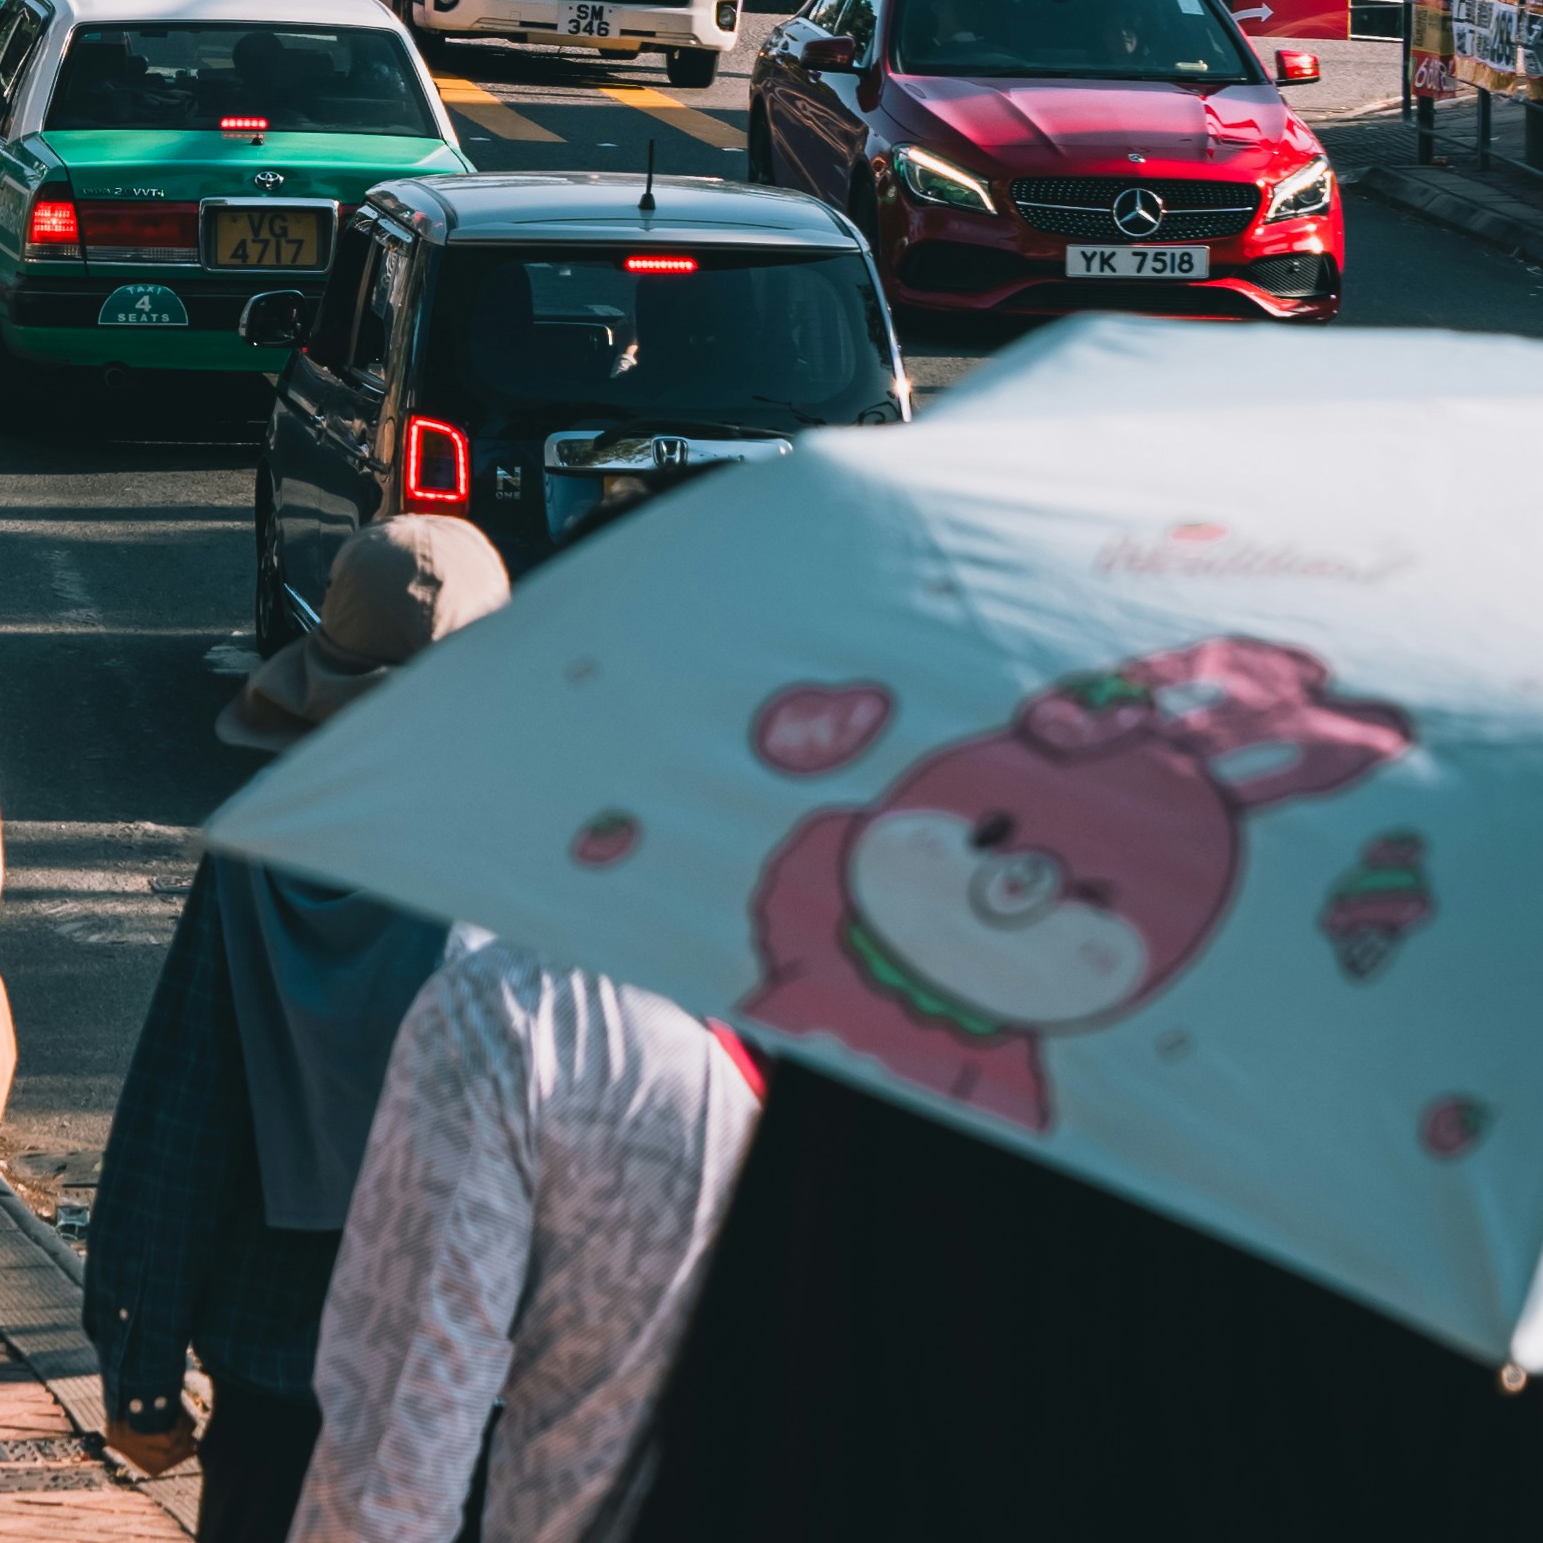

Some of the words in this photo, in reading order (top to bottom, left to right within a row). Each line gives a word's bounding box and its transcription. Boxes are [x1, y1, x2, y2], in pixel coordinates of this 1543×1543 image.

[576, 4, 604, 21] SM
[567, 19, 610, 37] 346
[247, 214, 289, 238] VG
[230, 239, 306, 264] 4717
[1080, 250, 1117, 274] YK
[1131, 251, 1195, 274] 7518
[125, 285, 163, 295] TAXI
[135, 295, 152, 312] 4
[117, 313, 170, 323] SEATS
[496, 466, 522, 491] N
[495, 492, 521, 500] ONE
